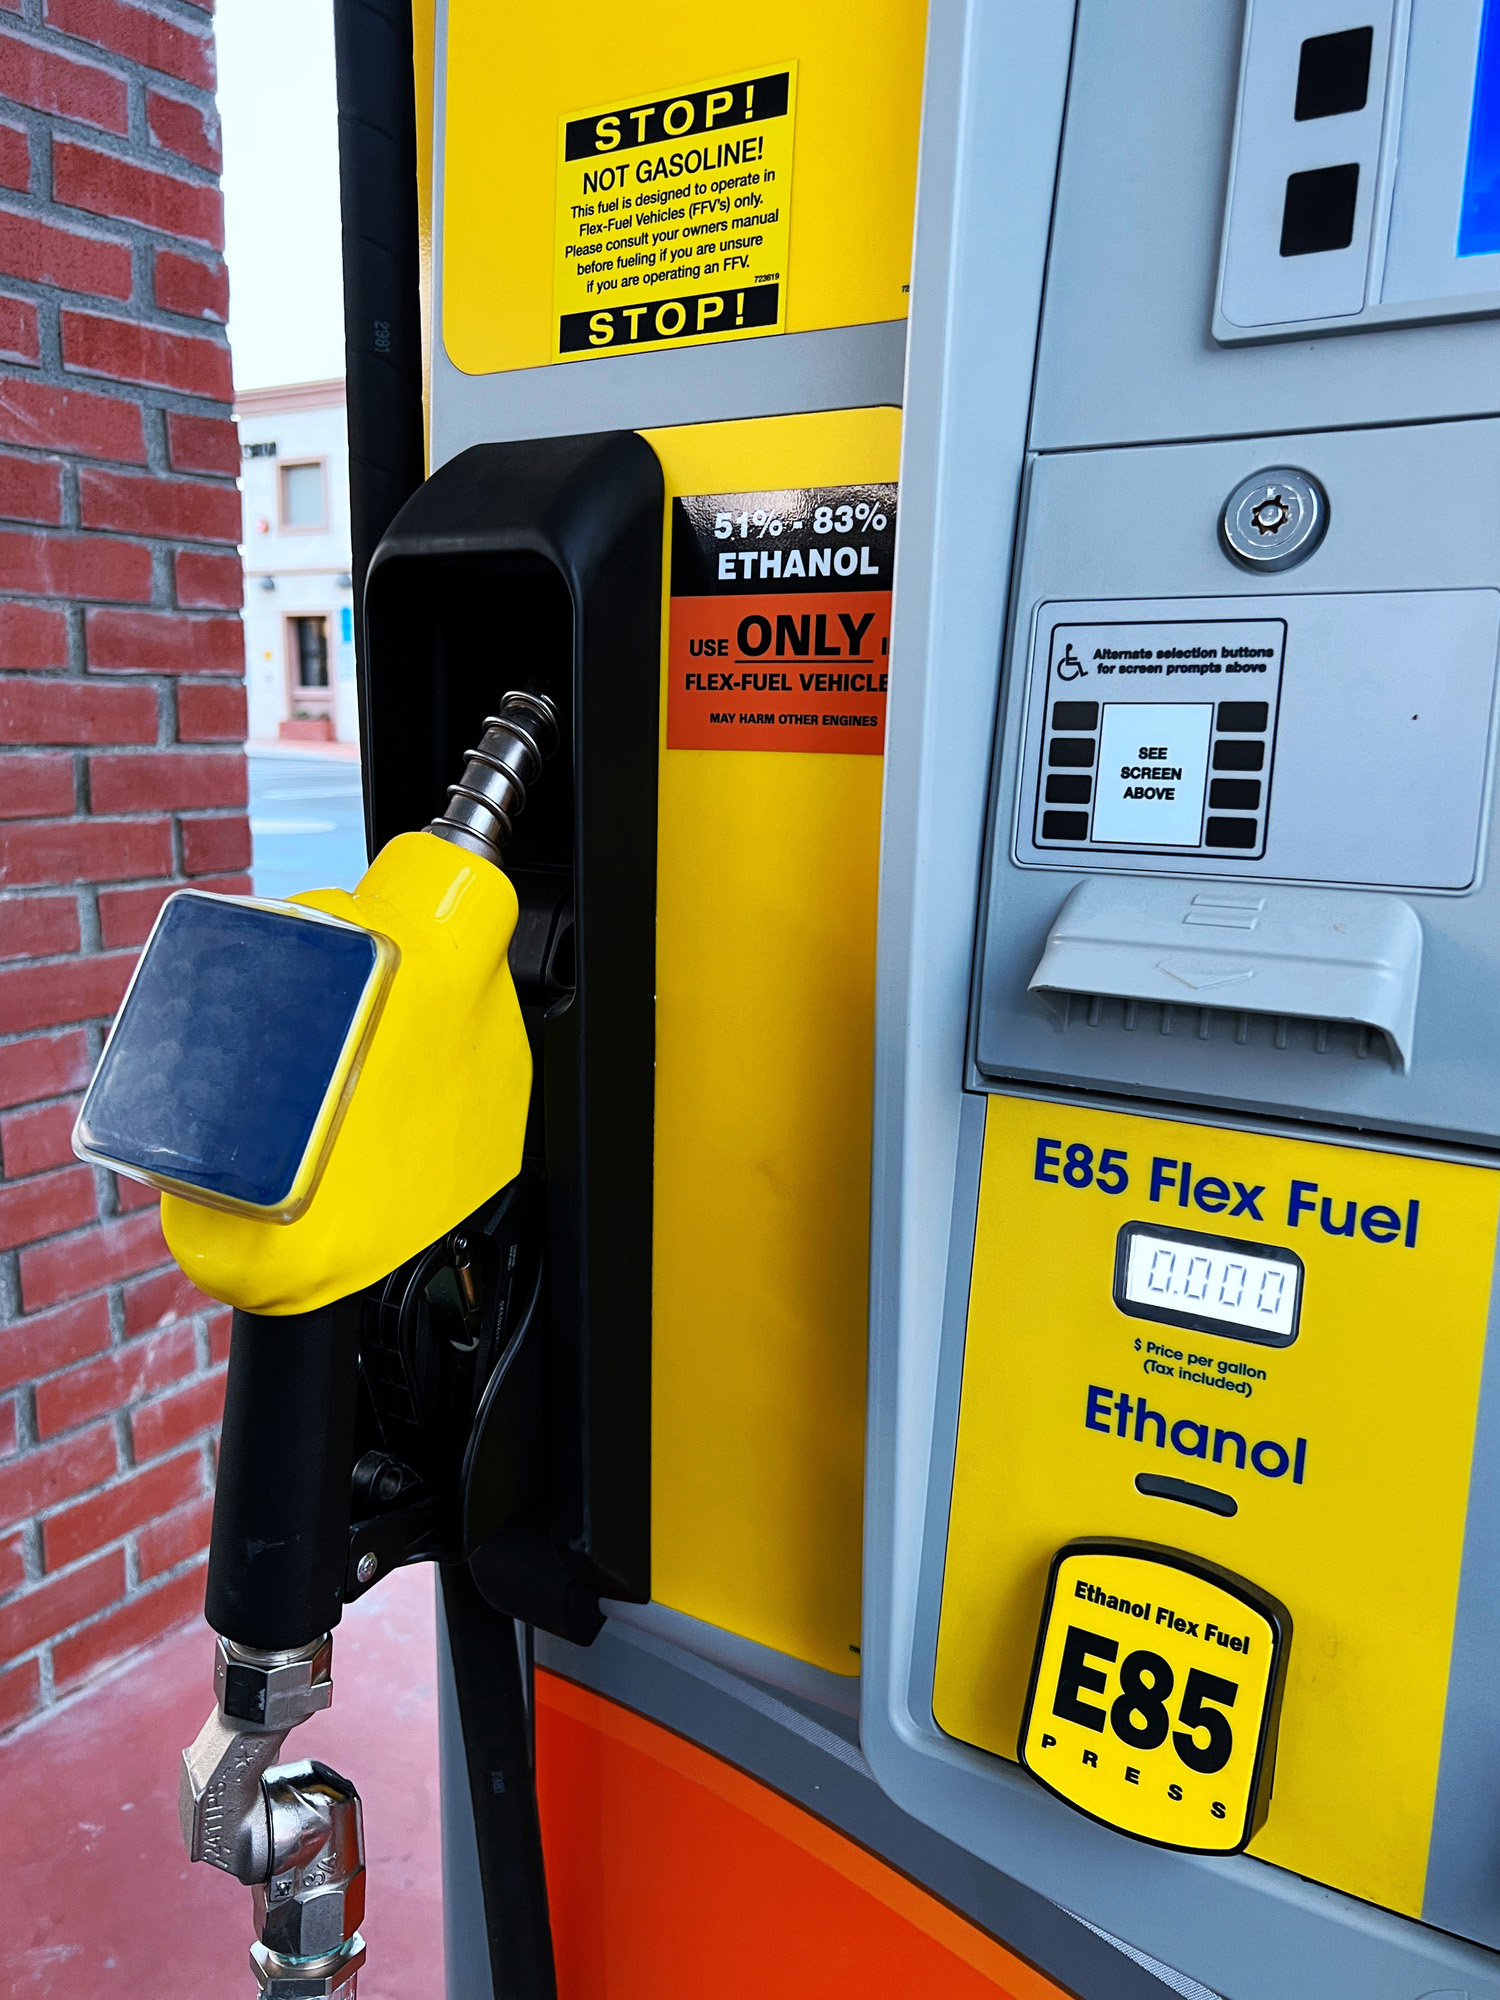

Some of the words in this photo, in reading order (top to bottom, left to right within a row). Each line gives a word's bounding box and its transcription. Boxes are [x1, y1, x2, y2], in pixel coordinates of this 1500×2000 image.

[595, 85, 755, 151] STOP!
[583, 164, 630, 194] NOT
[635, 137, 764, 184] GASOLINE!
[571, 205, 594, 219] This
[597, 198, 619, 216] fuel
[622, 197, 632, 210] is
[635, 185, 691, 212] designed
[694, 183, 707, 196] to
[710, 173, 760, 198] operate
[764, 169, 775, 183] in
[579, 211, 632, 236] Flex-Fuel
[635, 203, 685, 226] Vehicles
[688, 197, 731, 220] (FFV's)
[734, 191, 764, 210] only.
[565, 242, 603, 258] Please
[606, 234, 649, 252] consult
[652, 230, 679, 247] your
[682, 220, 728, 239] owners
[731, 209, 779, 229] manual
[577, 259, 613, 275] before
[616, 251, 656, 271] fueling
[659, 246, 668, 262] if
[670, 245, 693, 262] you
[696, 241, 716, 255] are
[719, 234, 763, 251] unsure
[586, 279, 594, 293] if
[596, 277, 619, 294] you
[621, 273, 640, 287] are
[643, 264, 701, 285] operating
[704, 260, 719, 274] an
[723, 255, 750, 271] FFV.
[754, 273, 780, 284] 723619
[588, 292, 745, 345] STOP!
[714, 509, 783, 539] 51%
[813, 501, 888, 535] 83%
[718, 546, 879, 580] ETHANOL
[689, 638, 729, 657] USE
[737, 613, 876, 657] ONLY
[1093, 648, 1152, 660] Alternate
[1156, 647, 1217, 659] selection
[1221, 646, 1274, 658] buttons
[686, 672, 793, 691] FLEX-FUEL
[799, 673, 888, 692] VEHICLE
[1097, 663, 1116, 675] for
[1119, 665, 1163, 675] screen
[1165, 663, 1222, 676] prompts
[1225, 662, 1267, 674] above
[710, 713, 736, 724] MAY
[739, 713, 775, 725] HARM
[778, 714, 819, 726] OTHER
[822, 715, 878, 727] ENGINES
[1120, 767, 1182, 781] SCREEN
[1138, 747, 1168, 760] SEE
[1123, 787, 1176, 801] ABOVE
[1034, 1137, 1129, 1195] E85
[1149, 1157, 1266, 1222] Flex
[1287, 1180, 1420, 1248] Fuel
[1147, 1249, 1286, 1315] 0.000
[1134, 1338, 1142, 1352] $
[1146, 1340, 1184, 1361] Price
[1187, 1352, 1214, 1370] per
[1217, 1357, 1267, 1381] gallon
[1143, 1359, 1175, 1378] (Tax
[1178, 1366, 1253, 1398] included)
[1085, 1384, 1307, 1485] Ethanol
[1074, 1579, 1151, 1620] Ethanol
[1156, 1607, 1199, 1637] Flex
[1204, 1623, 1250, 1655] Fuel
[1052, 1624, 1239, 1775] E85
[1041, 1733, 1226, 1819] PRESS
